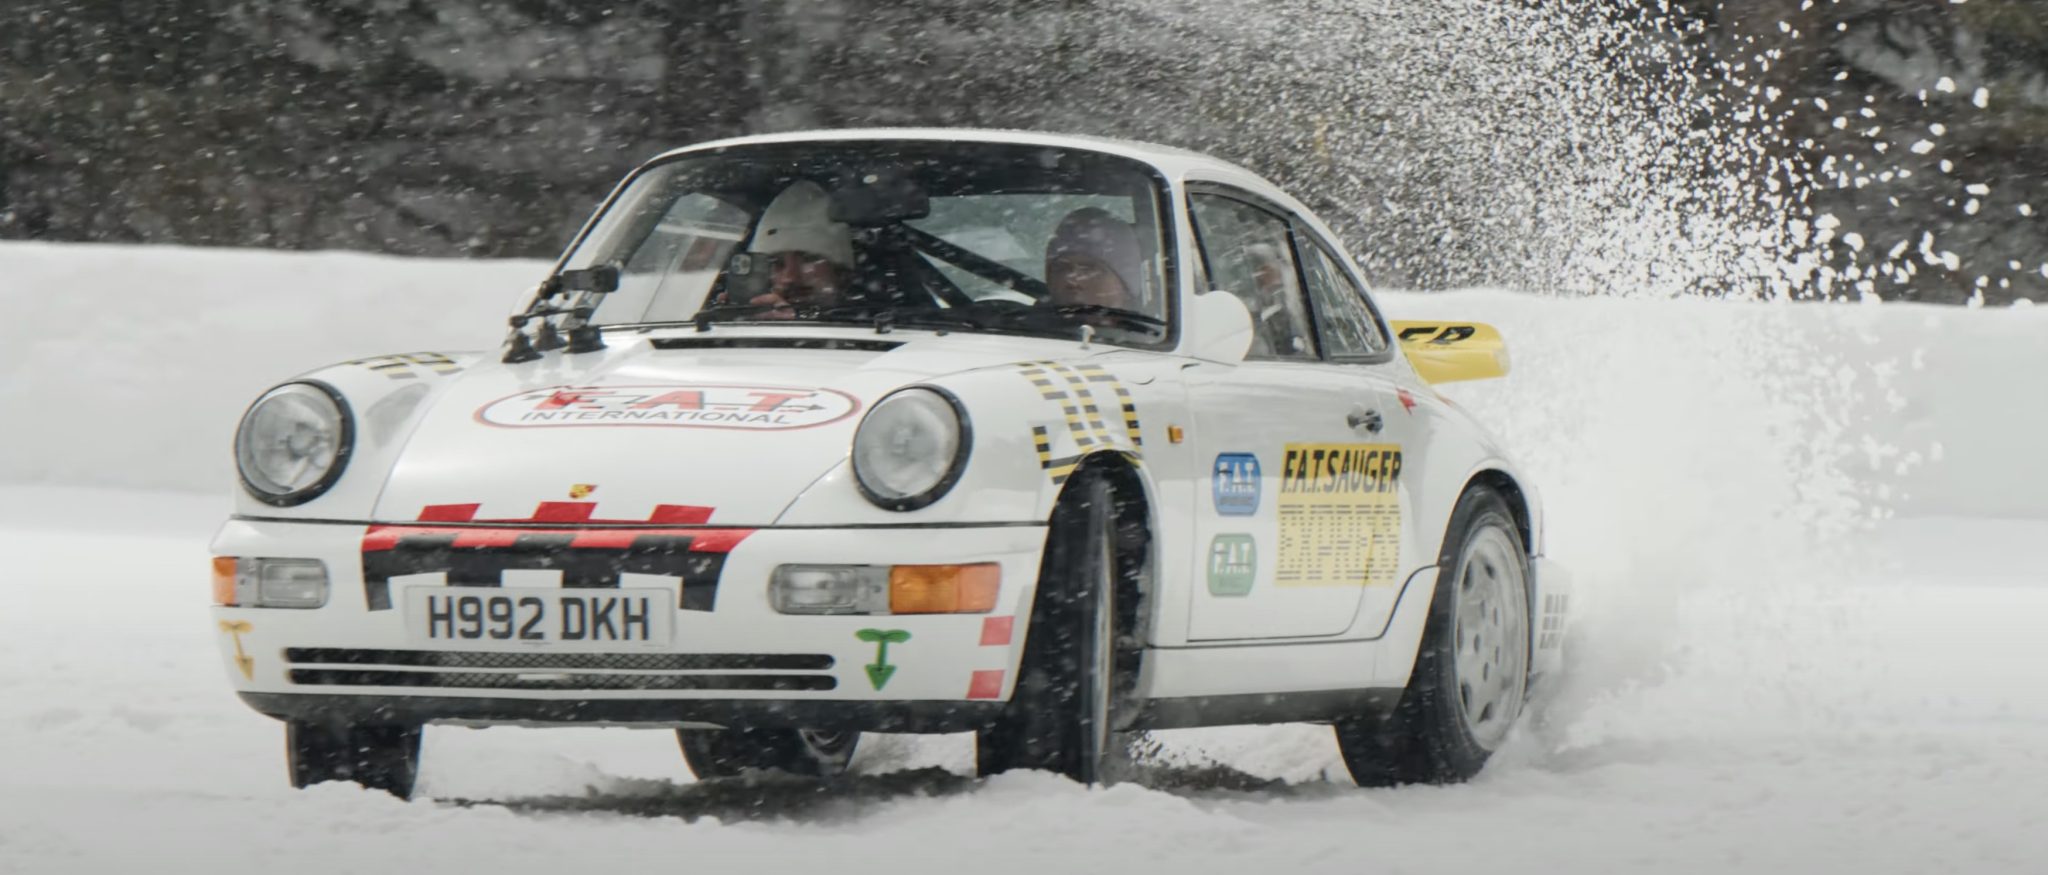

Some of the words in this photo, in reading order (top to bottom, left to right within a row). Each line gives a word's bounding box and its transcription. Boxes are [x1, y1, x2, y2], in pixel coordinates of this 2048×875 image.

[520, 410, 792, 425] INTERNATIONAL
[427, 595, 545, 641] H992
[559, 596, 650, 642] DKH
